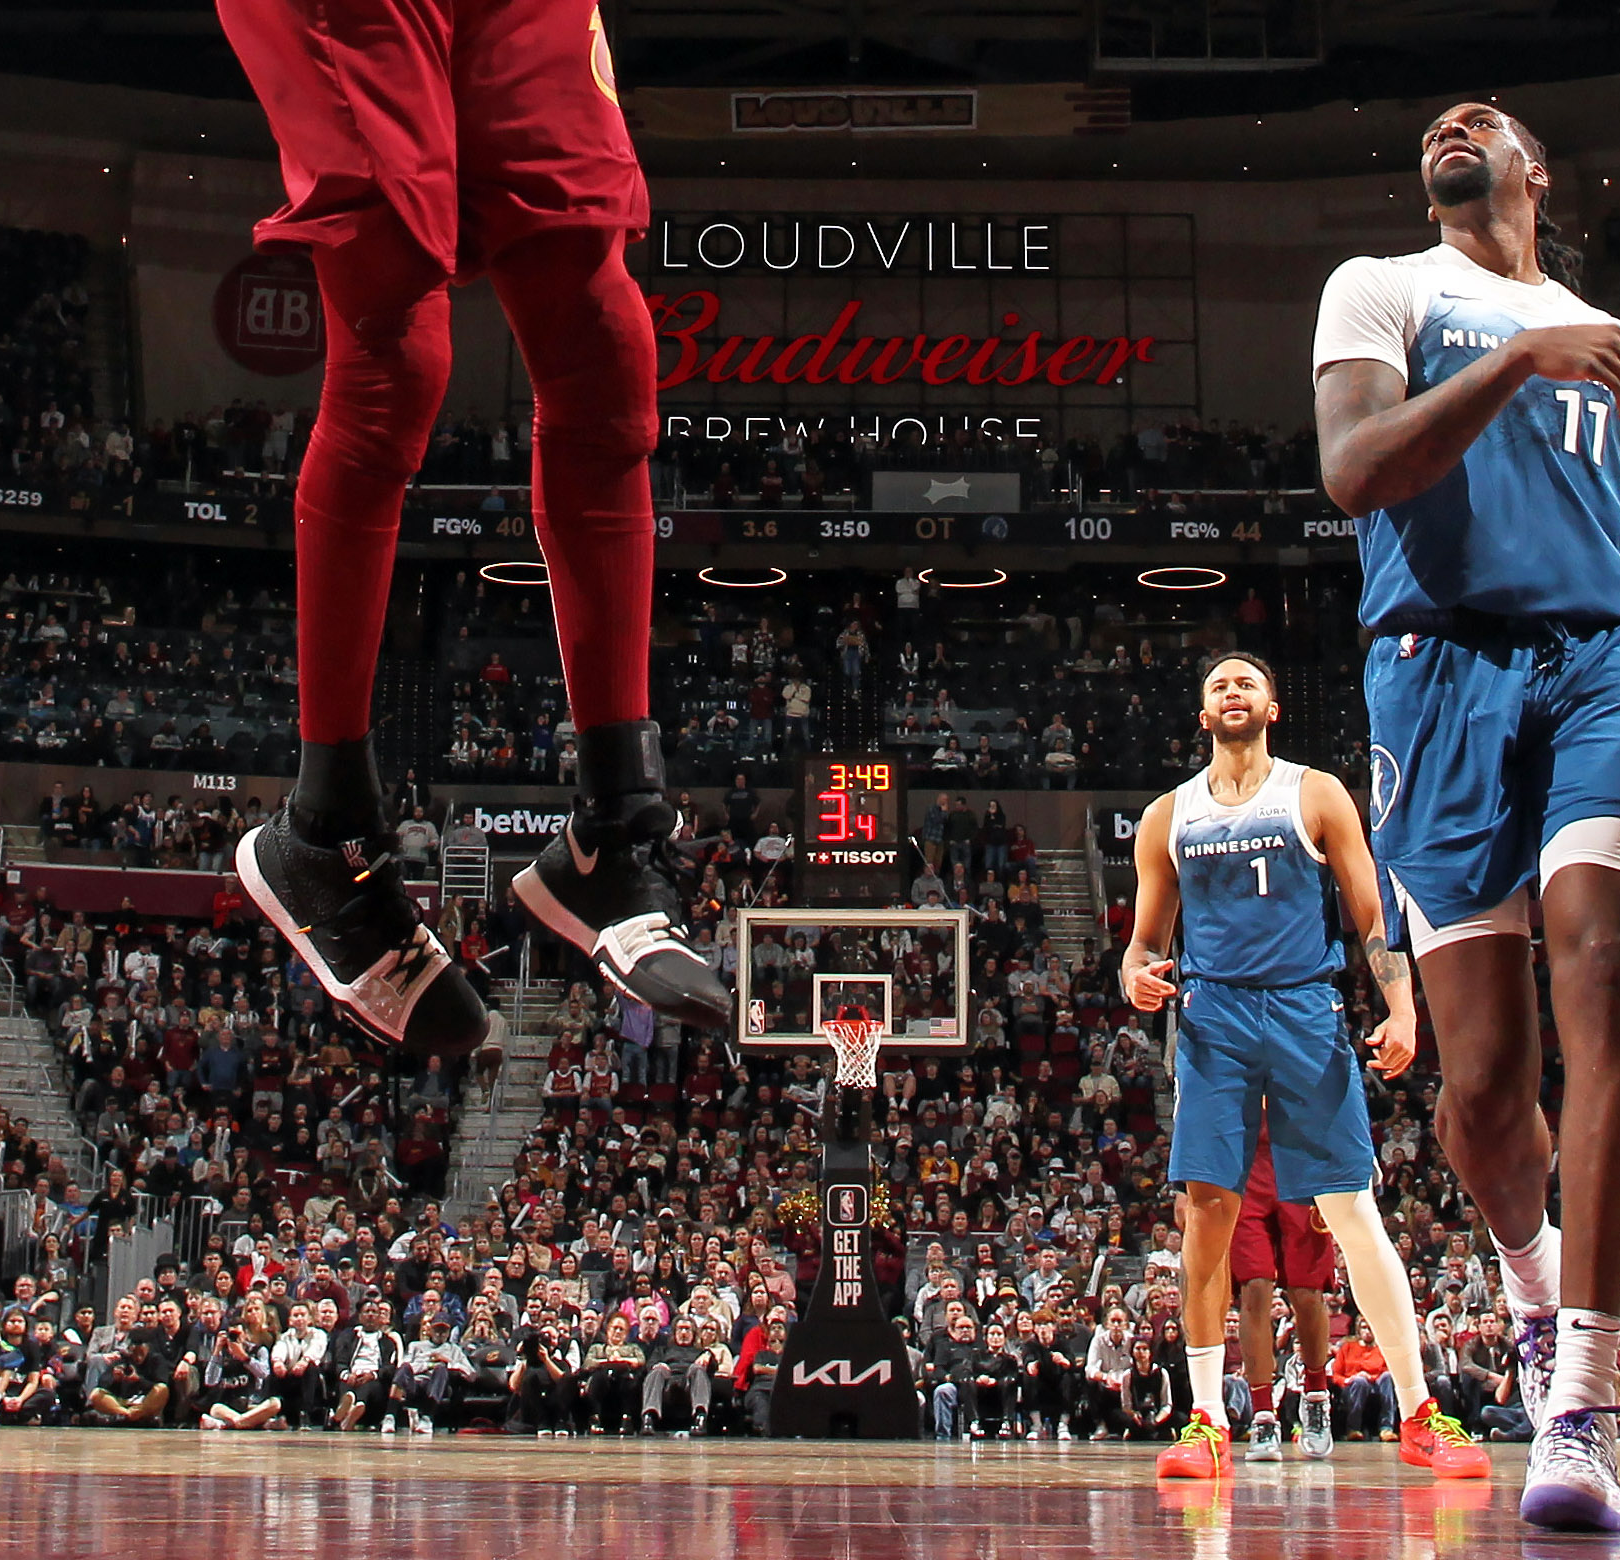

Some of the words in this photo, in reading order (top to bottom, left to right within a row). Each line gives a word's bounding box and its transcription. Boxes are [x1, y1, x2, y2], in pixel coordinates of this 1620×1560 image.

[662, 220, 1050, 271] LOUDVILLE
[649, 290, 1156, 392] Budweiser
[1555, 388, 1612, 467] 11
[184, 501, 227, 522] TOL
[245, 505, 258, 524] 2
[432, 517, 482, 536] FG%
[495, 516, 526, 538] 40
[742, 521, 778, 537] 3.6
[819, 520, 871, 538] 3:50
[915, 516, 955, 540] OT
[1064, 516, 1112, 541] 100
[1170, 521, 1221, 539] FG%
[1231, 521, 1262, 541] 44
[192, 773, 237, 793] M113
[829, 763, 891, 792] 3:49
[474, 807, 569, 834] betwa
[817, 791, 877, 842] 3.4
[831, 850, 898, 864] TISSOT
[1183, 834, 1286, 859] MINNESOTA
[1248, 856, 1270, 897] 1
[833, 1229, 861, 1255] GET
[833, 1256, 862, 1281] THE
[833, 1282, 862, 1307] APP
